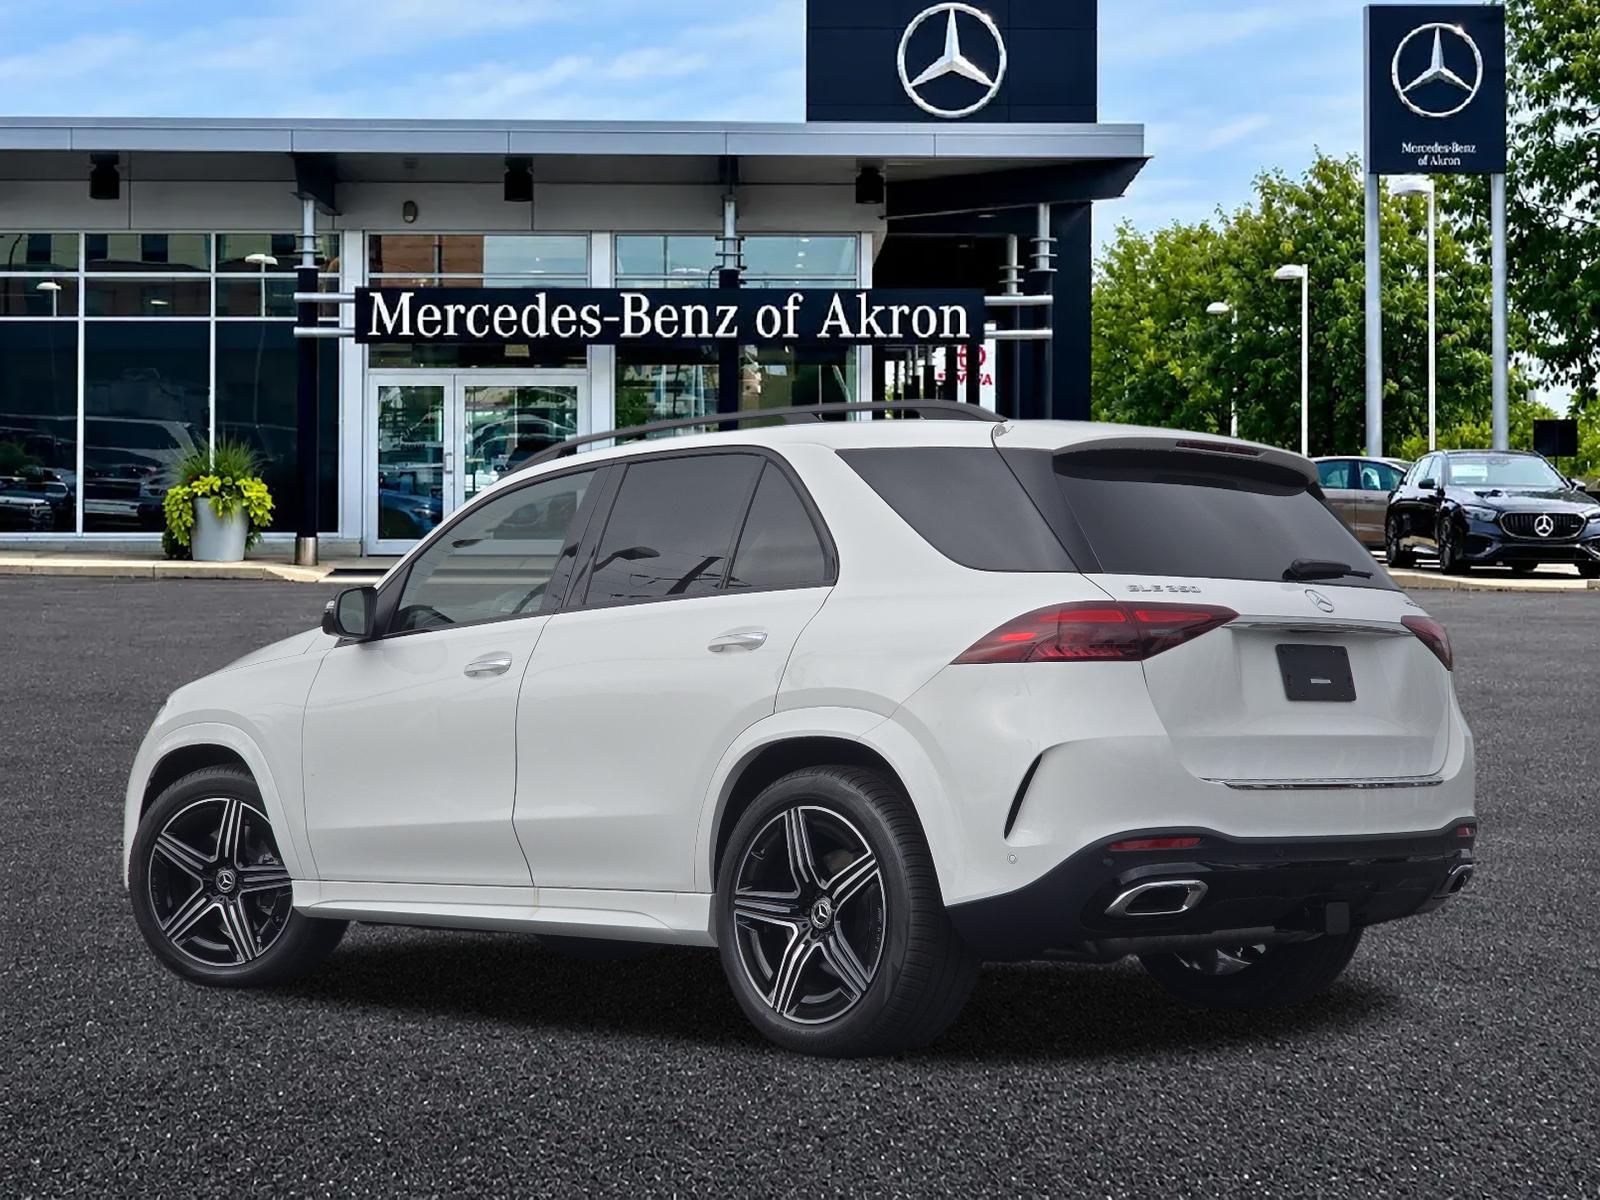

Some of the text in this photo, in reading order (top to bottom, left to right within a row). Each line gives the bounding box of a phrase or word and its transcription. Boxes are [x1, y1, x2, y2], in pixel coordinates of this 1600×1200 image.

[1401, 141, 1477, 154] Mercedes-Benz
[1417, 154, 1461, 166] of Akron
[367, 291, 971, 338] Mercedes-Benz of Akron
